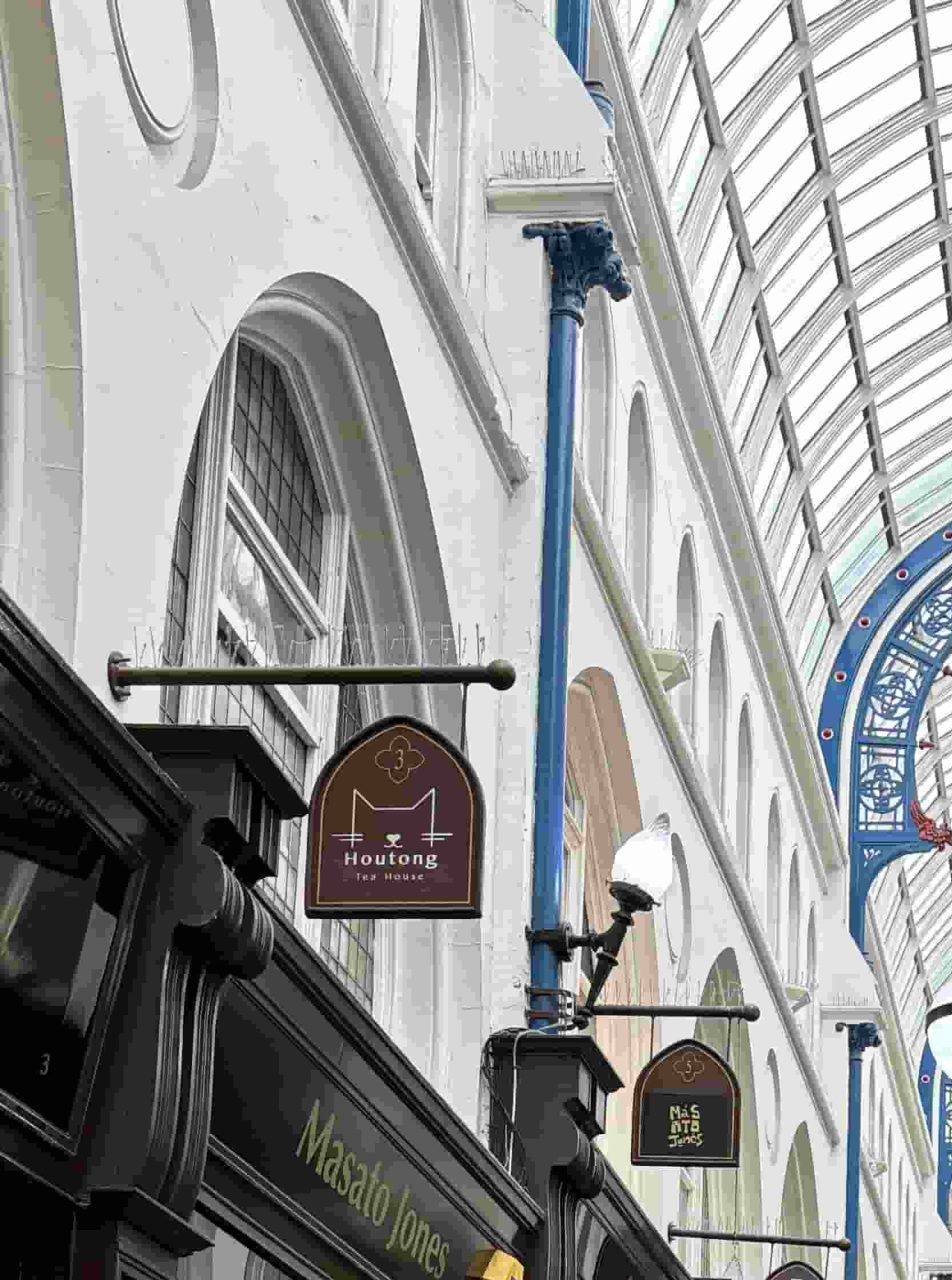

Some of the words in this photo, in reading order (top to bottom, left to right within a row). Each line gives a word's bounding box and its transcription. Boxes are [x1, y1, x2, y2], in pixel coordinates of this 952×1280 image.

[394, 749, 404, 770] 3
[344, 851, 438, 869] Houtong
[356, 872, 376, 881] Tea
[384, 872, 425, 881] House
[40, 1053, 50, 1075] 3
[296, 1099, 390, 1227] Masato
[386, 1184, 449, 1279] Jones
